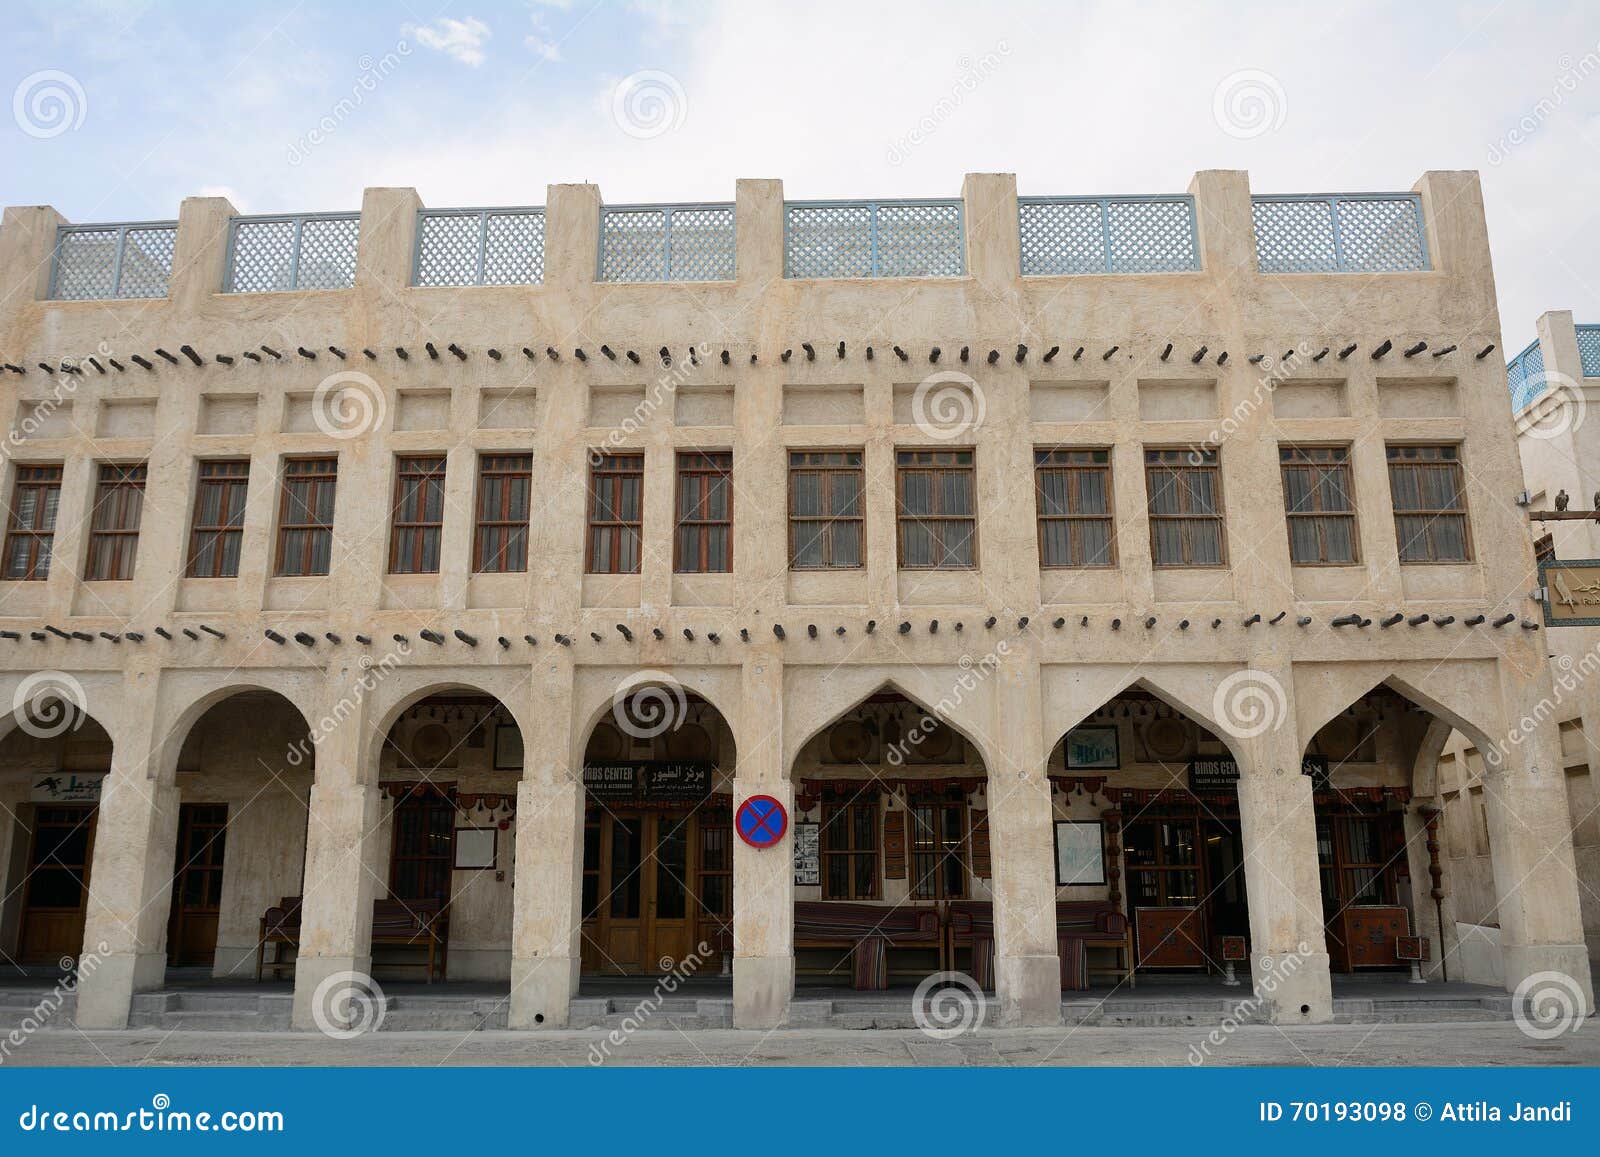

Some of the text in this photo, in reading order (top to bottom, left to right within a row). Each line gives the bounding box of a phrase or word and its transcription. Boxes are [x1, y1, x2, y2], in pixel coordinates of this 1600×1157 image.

[584, 767, 633, 781] IRDS CENTER
[651, 764, 705, 783] مركز الطيور
[1194, 761, 1220, 775] BIRDS
